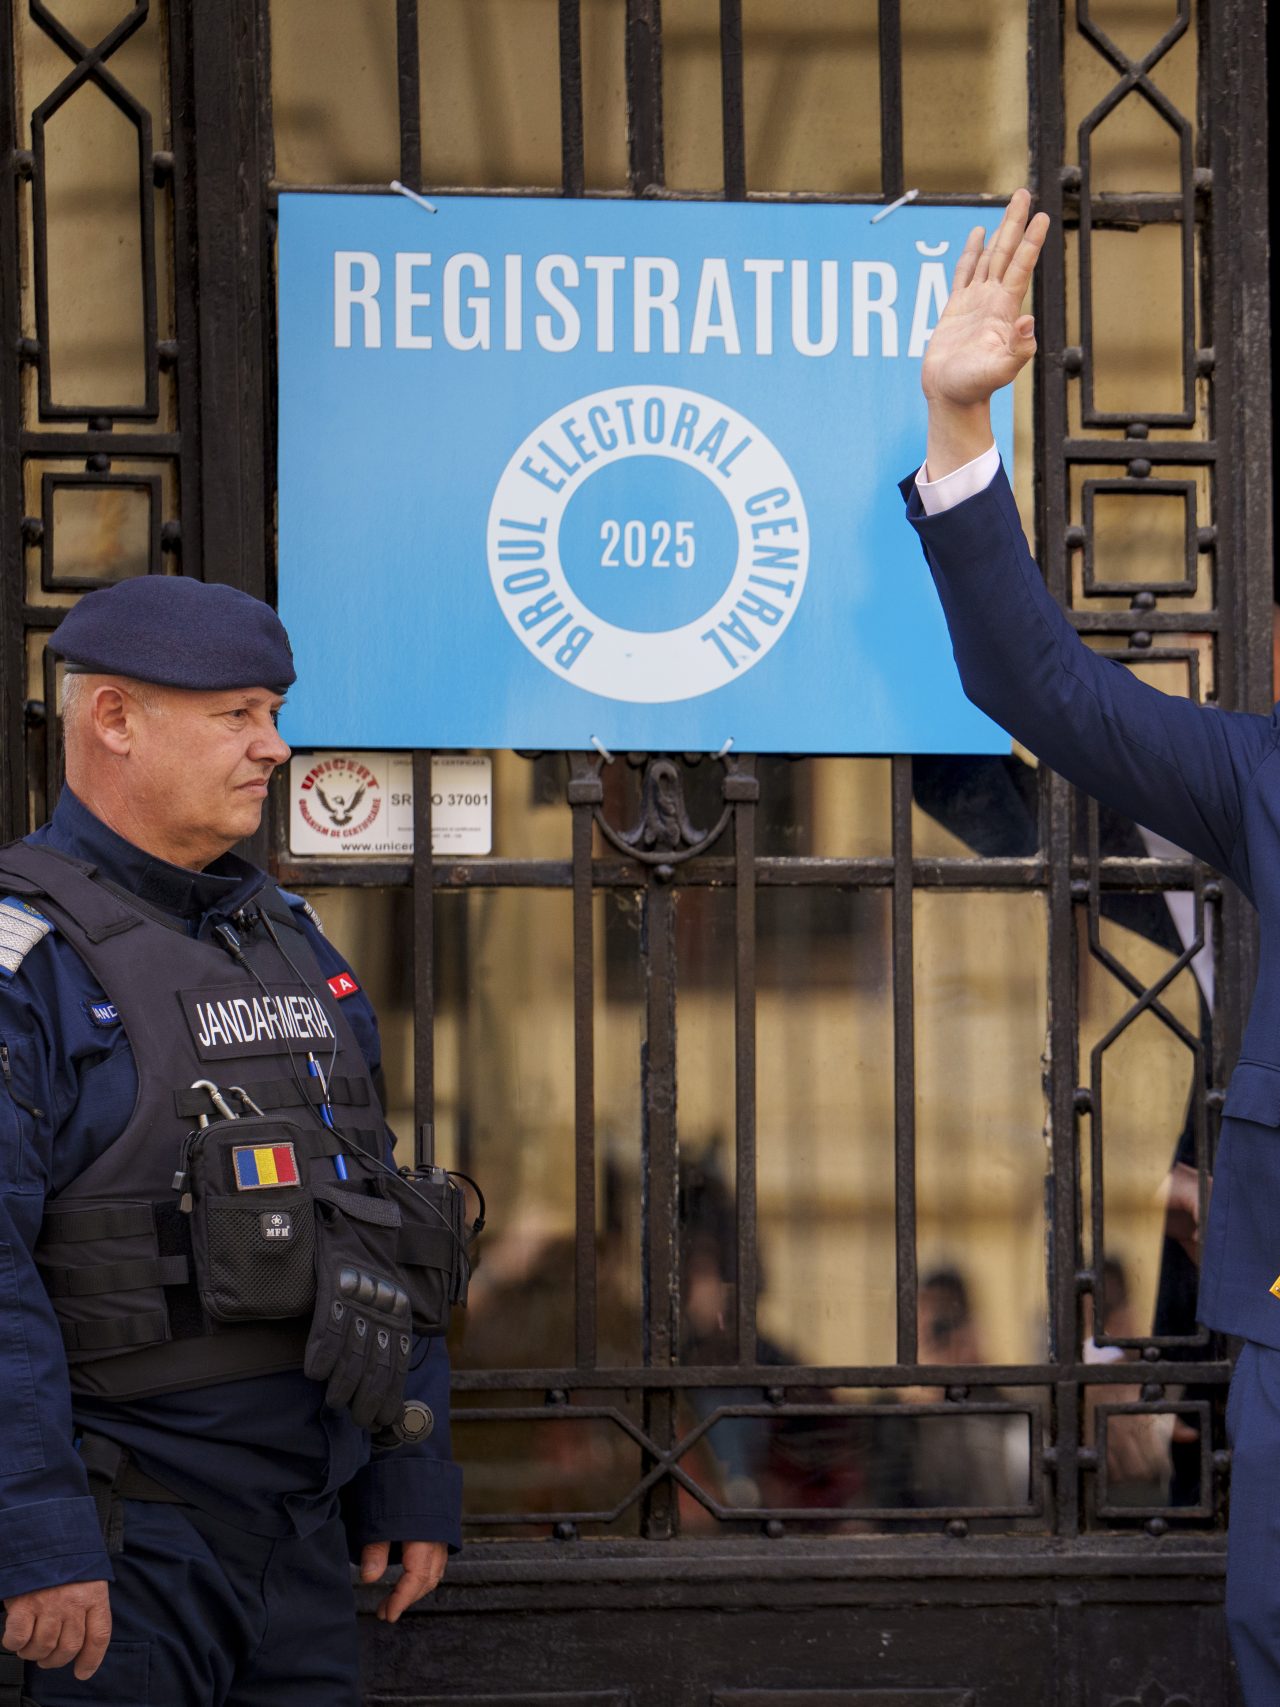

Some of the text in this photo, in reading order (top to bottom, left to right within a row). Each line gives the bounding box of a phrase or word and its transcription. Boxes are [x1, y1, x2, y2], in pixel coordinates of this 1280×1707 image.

[334, 241, 949, 358] REGISTRATURĂ
[498, 397, 800, 671] BIROUL ELECTORAL CENTRAL
[600, 520, 696, 569] 2025
[301, 758, 379, 790] UNICERT
[447, 793, 488, 807] 37001
[196, 995, 335, 1047] JANDARMERIA
[266, 1228, 289, 1237] MFH
